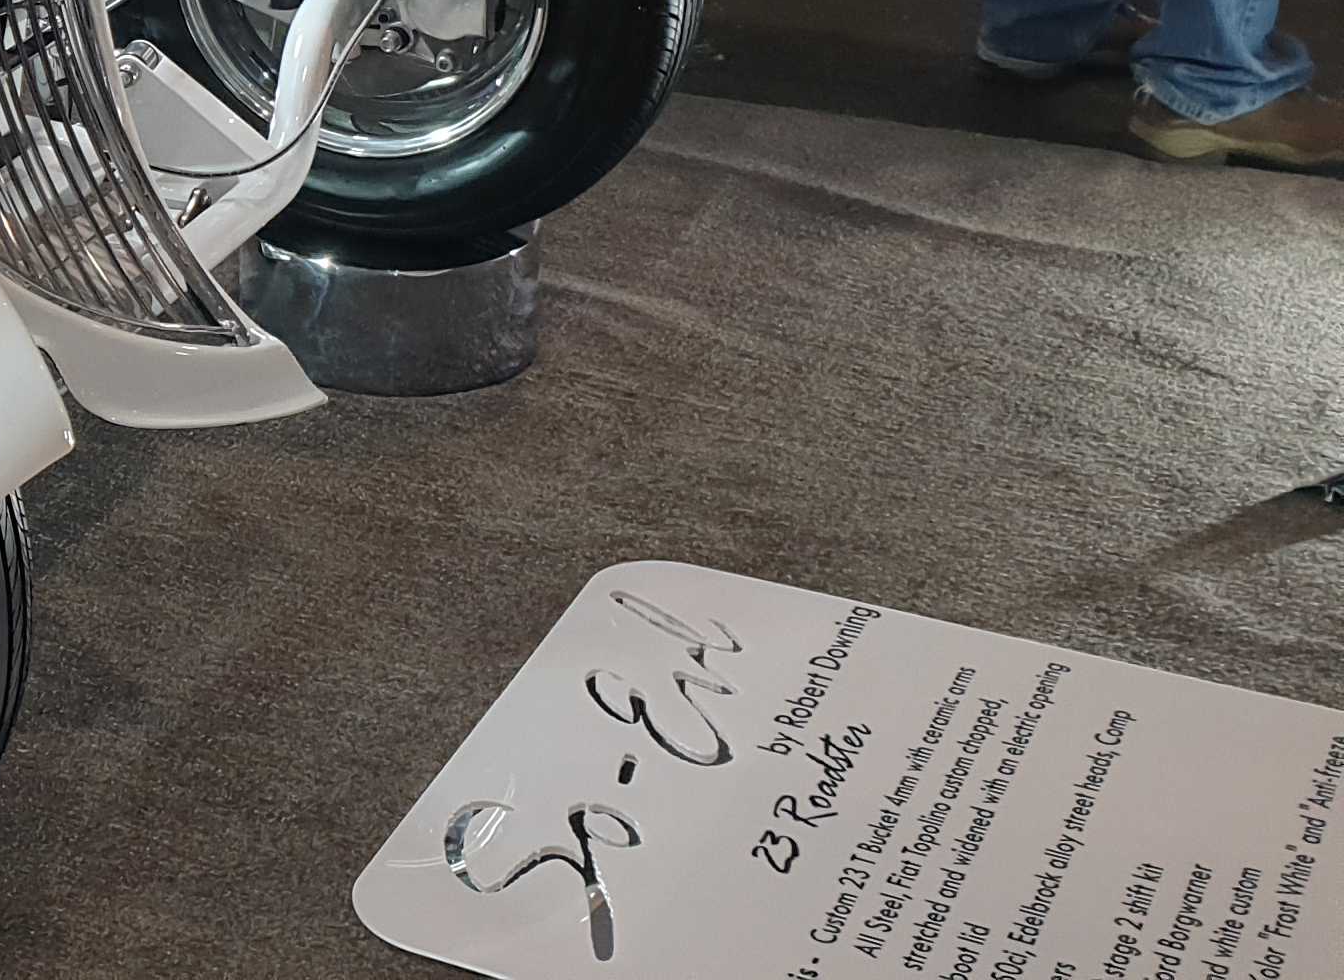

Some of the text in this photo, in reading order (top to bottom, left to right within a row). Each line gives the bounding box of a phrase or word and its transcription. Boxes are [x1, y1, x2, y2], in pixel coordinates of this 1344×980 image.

[757, 606, 882, 755] by Robert Downing
[949, 667, 976, 696] arms
[924, 697, 960, 745] ceramic
[1096, 709, 1136, 747] Comp
[906, 747, 934, 773] with
[1074, 745, 1120, 792] heads,
[752, 723, 872, 874] 23 Roadster
[884, 774, 919, 806] 4mm
[1064, 792, 1096, 832] street
[854, 697, 1009, 958] All Steel, Fiat Topolino custom chopped,
[857, 809, 901, 855] Bucket
[904, 662, 1070, 970] stretched and widened with an electric opening
[1299, 815, 1327, 844] and
[851, 853, 876, 866] T
[1044, 833, 1085, 869] alloy
[839, 868, 870, 889] 23
[811, 891, 858, 944] Custom
[1007, 871, 1062, 945] Edelbrock
[1103, 863, 1164, 977] stage 2 shift kit
[1158, 864, 1213, 951] Borgwarner
[1210, 918, 1245, 958] white
[1230, 867, 1262, 915] custom
[958, 922, 991, 945] lid
